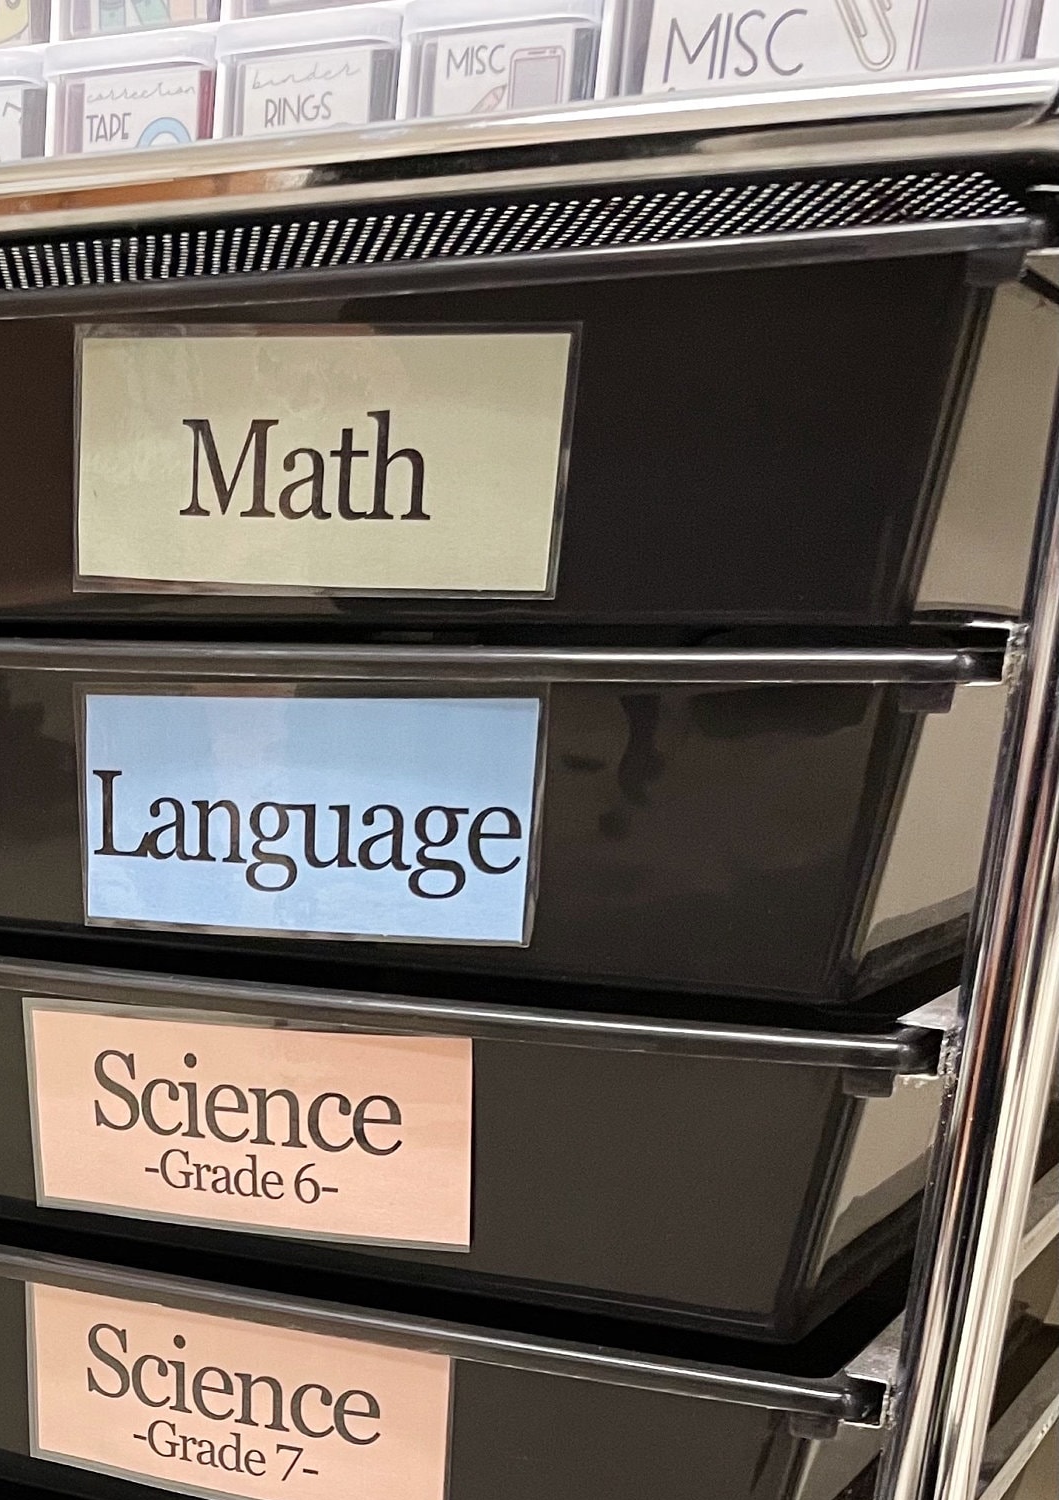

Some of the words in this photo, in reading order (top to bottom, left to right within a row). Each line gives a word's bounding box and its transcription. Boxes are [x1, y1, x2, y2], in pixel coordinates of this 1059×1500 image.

[251, 61, 361, 90] binder
[445, 43, 506, 79] MISC
[662, 8, 809, 84] MISC
[86, 81, 196, 103] correction
[264, 91, 333, 128] RINGS
[86, 112, 133, 143] TAPE
[180, 409, 431, 521] Math
[92, 769, 522, 899] Language
[94, 1049, 403, 1156] Science
[144, 1148, 285, 1200] -Grade
[294, 1163, 339, 1204] 6-
[87, 1323, 381, 1446] Science
[133, 1419, 266, 1477] -Grade
[276, 1443, 319, 1482] 7-
